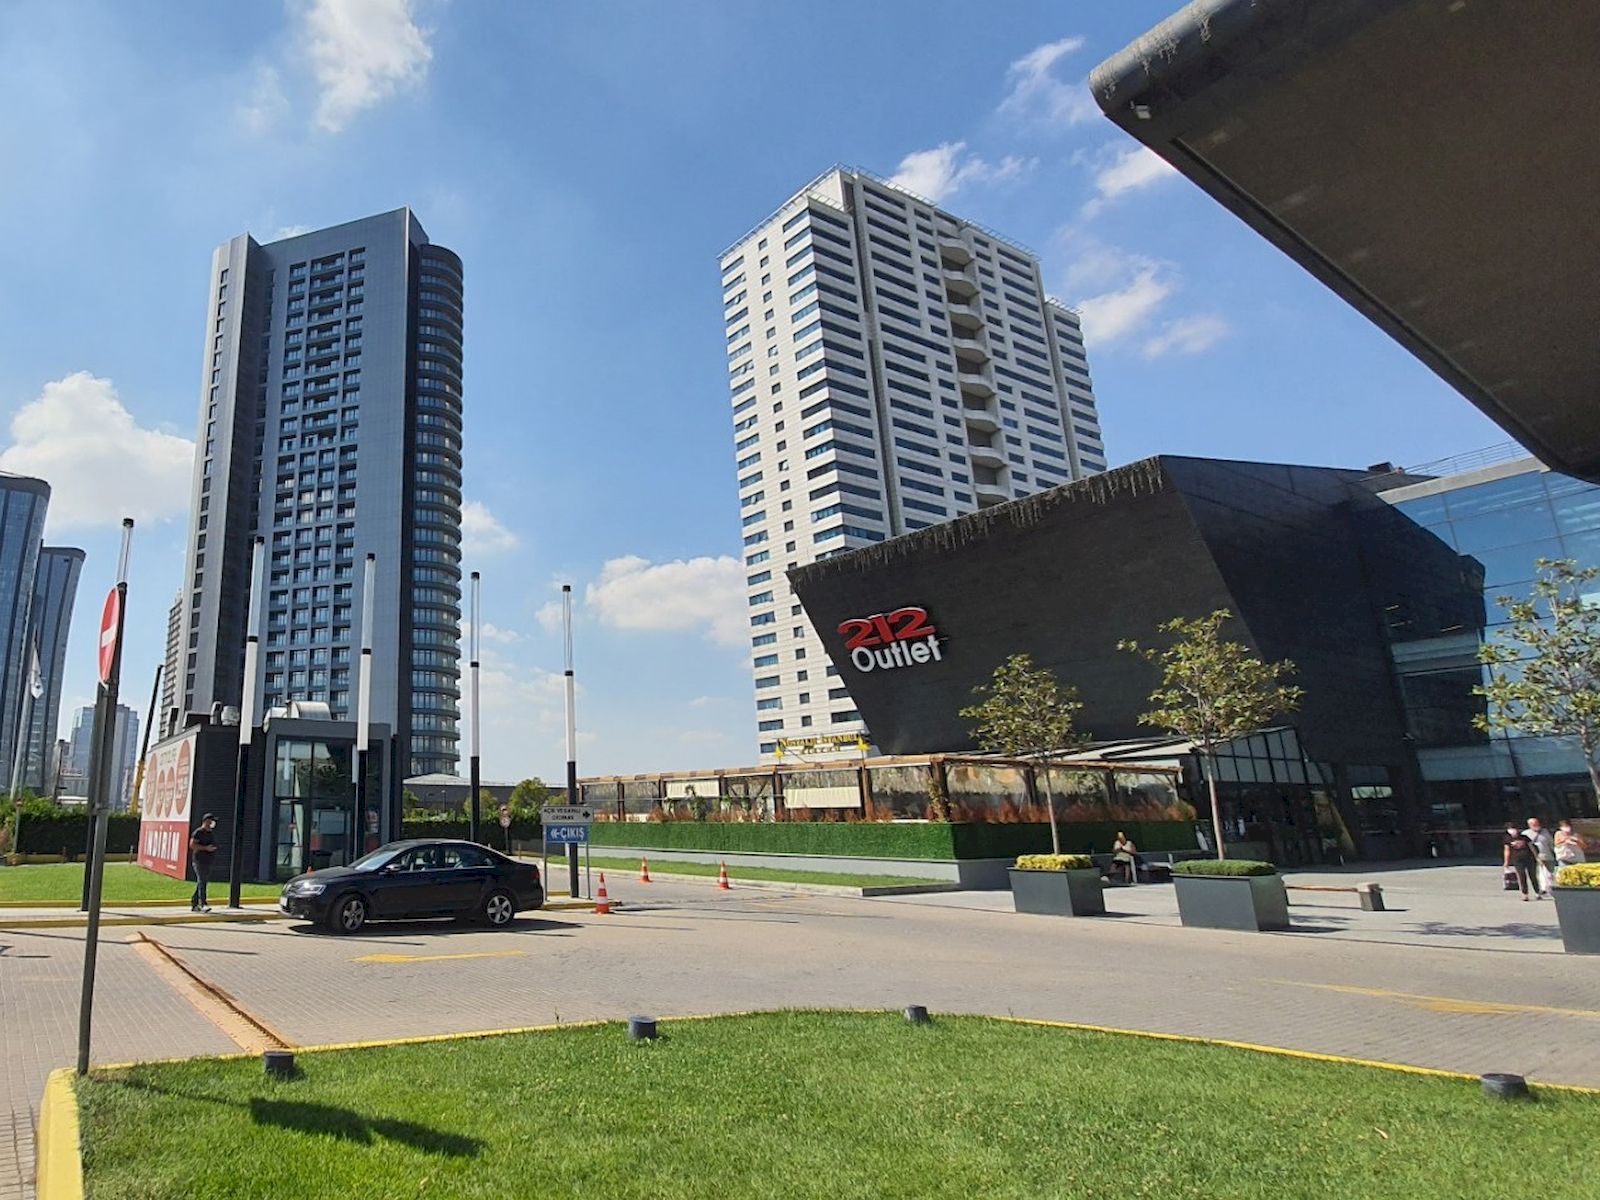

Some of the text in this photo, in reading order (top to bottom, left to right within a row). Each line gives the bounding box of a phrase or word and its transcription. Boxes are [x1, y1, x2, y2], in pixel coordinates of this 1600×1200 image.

[837, 607, 936, 649] 212
[852, 634, 942, 672] Outlet
[144, 823, 180, 862] İNDİRİM
[560, 827, 585, 840] ÇIKIŞ
